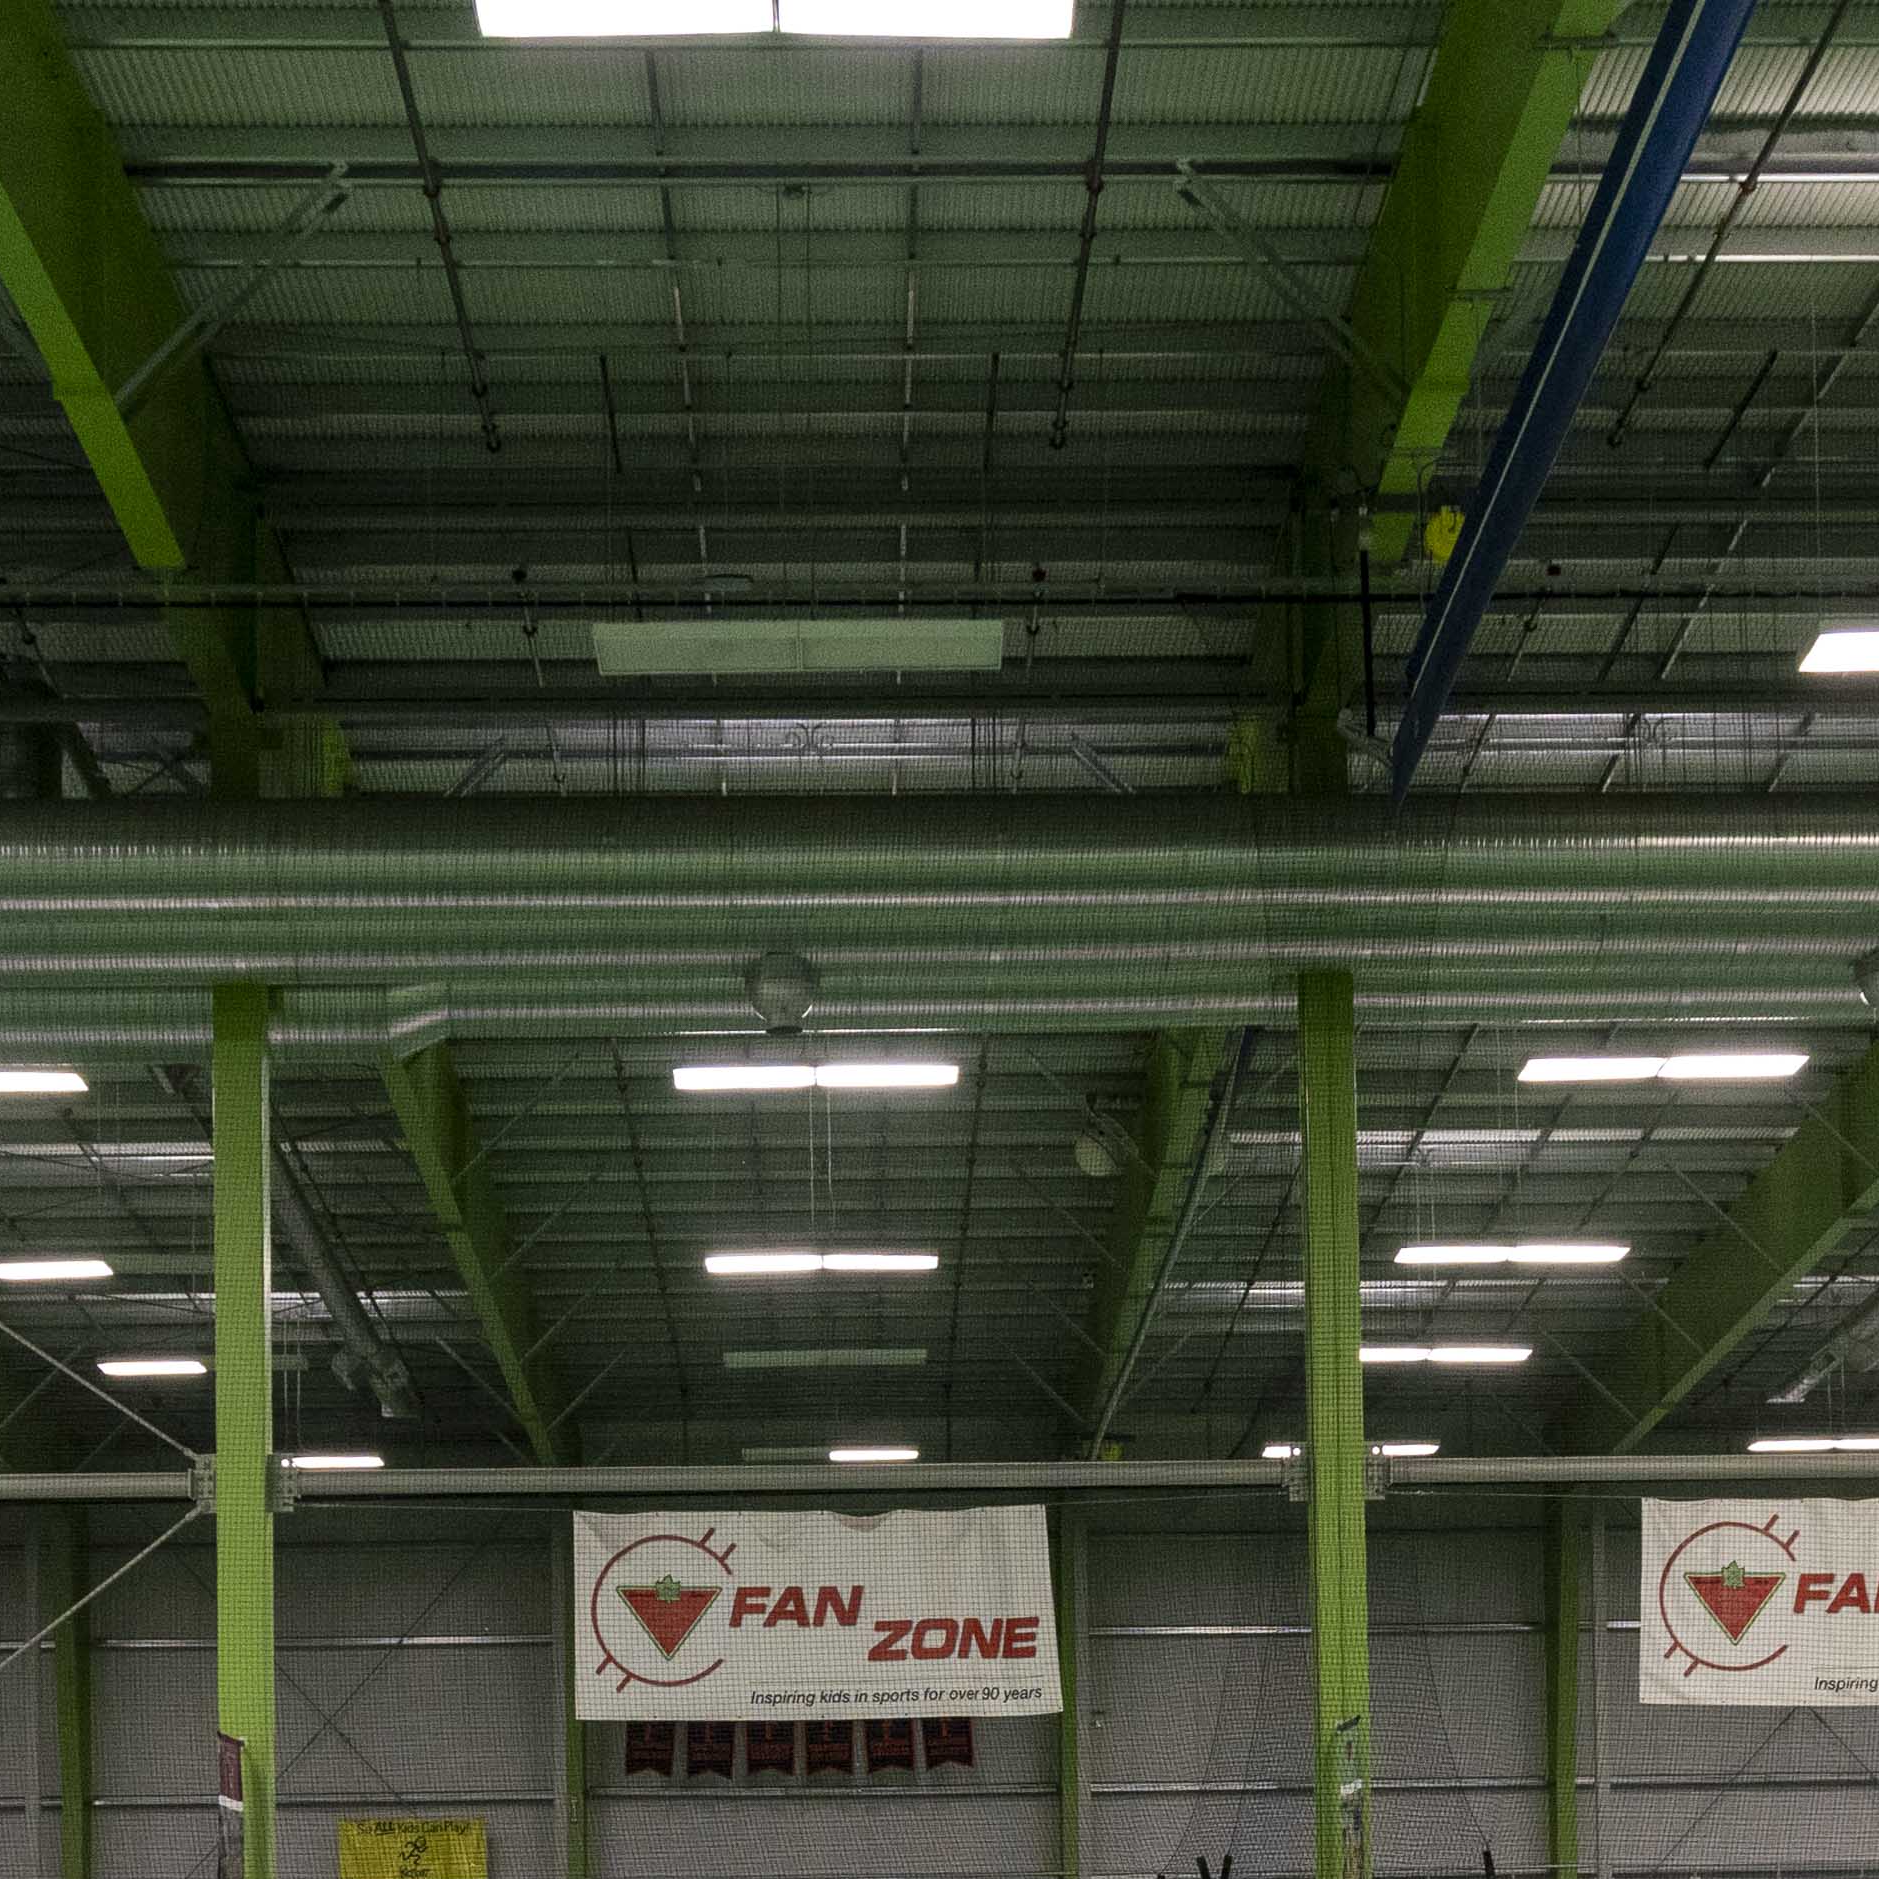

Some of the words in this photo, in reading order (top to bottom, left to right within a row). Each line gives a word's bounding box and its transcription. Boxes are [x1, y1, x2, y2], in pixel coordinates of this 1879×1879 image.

[729, 1585, 864, 1628] FAN
[868, 1617, 1039, 1661] ZONE
[1814, 1677, 1878, 1692] Inspiring
[750, 1691, 816, 1706] Inspiring
[819, 1690, 850, 1704] kids
[854, 1689, 868, 1703] in
[872, 1688, 920, 1705] sports
[923, 1687, 946, 1701] for
[949, 1689, 980, 1701] over
[981, 1688, 1001, 1701] 90
[1003, 1687, 1042, 1703] years
[375, 1822, 395, 1833] ALL
[421, 1821, 443, 1833] Can
